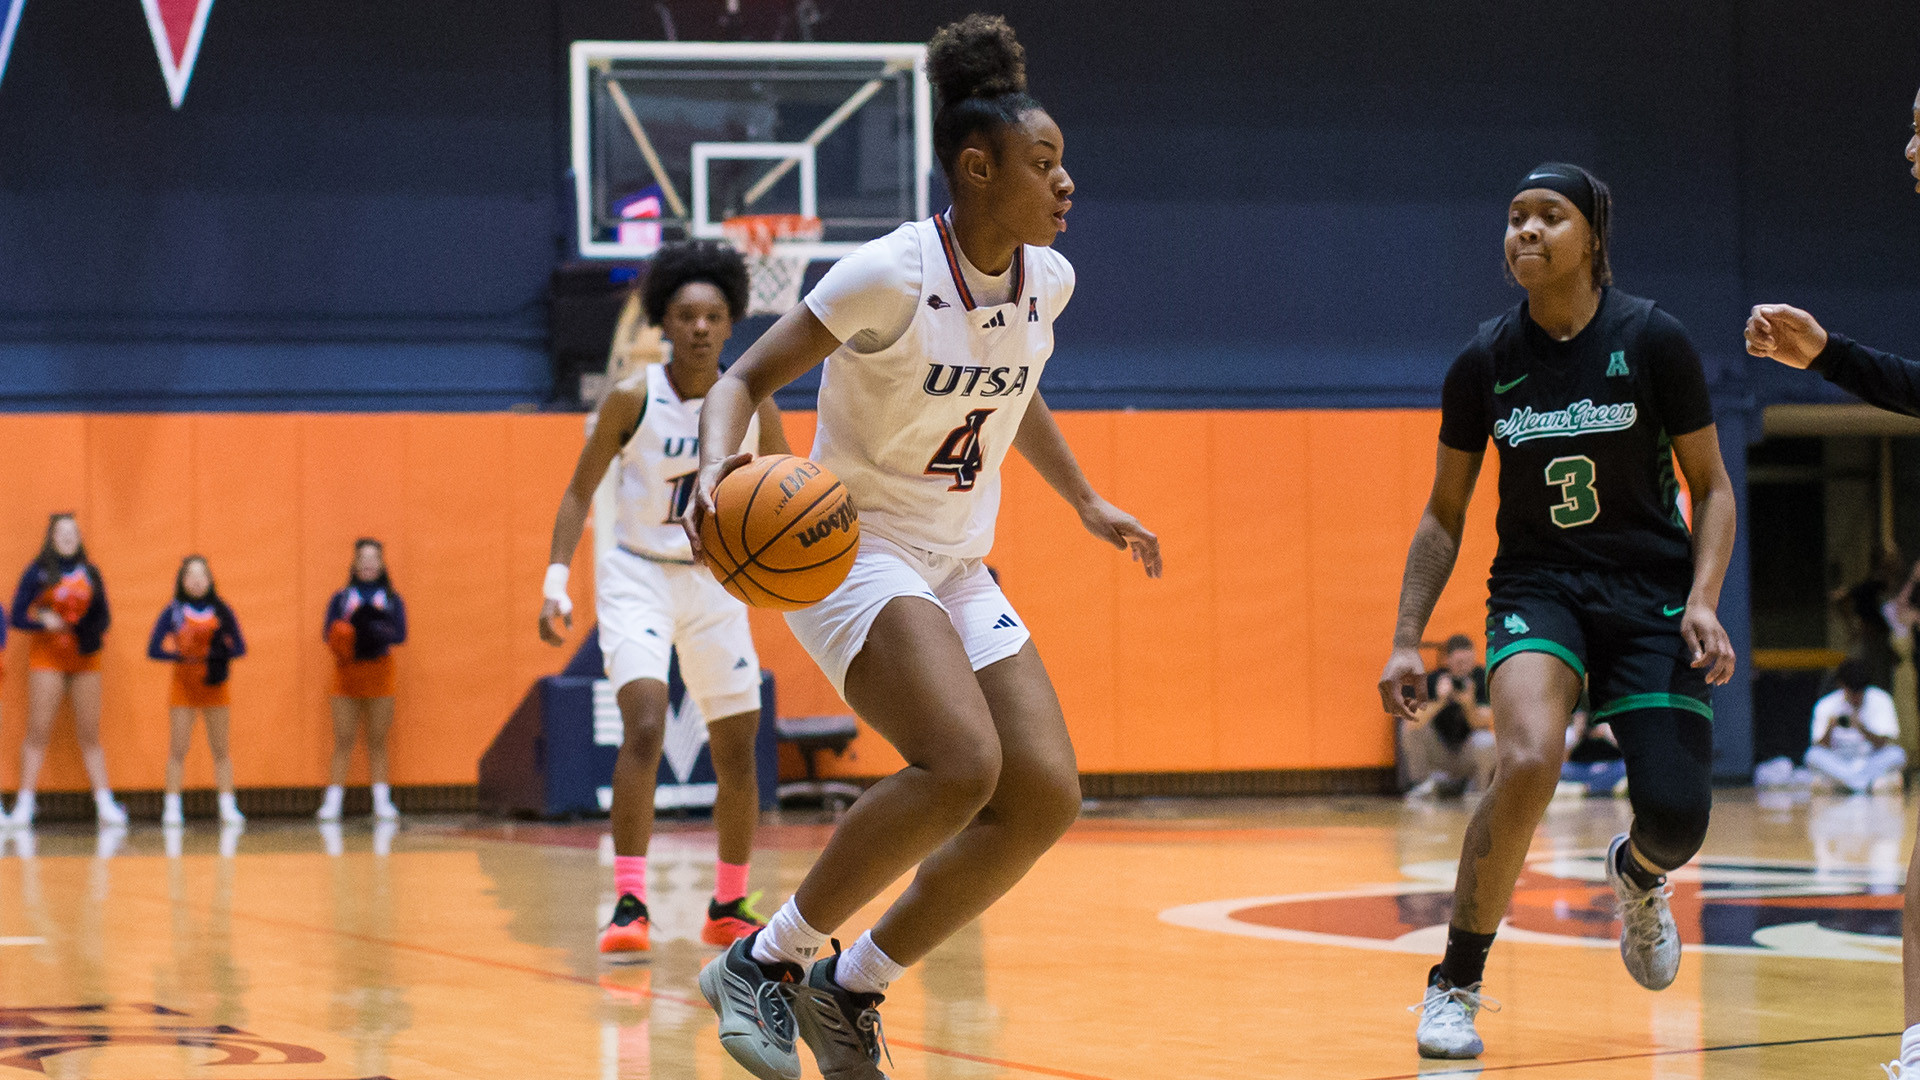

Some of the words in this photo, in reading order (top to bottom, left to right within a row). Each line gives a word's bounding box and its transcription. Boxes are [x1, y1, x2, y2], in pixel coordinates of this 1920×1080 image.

[923, 363, 1029, 397] UTSA
[1606, 351, 1630, 377] A
[1495, 405, 1566, 439] Mean
[1567, 399, 1637, 429] Green
[664, 437, 699, 457] UT
[924, 408, 998, 492] 4
[780, 462, 821, 499] EVO
[1545, 455, 1600, 529] 3
